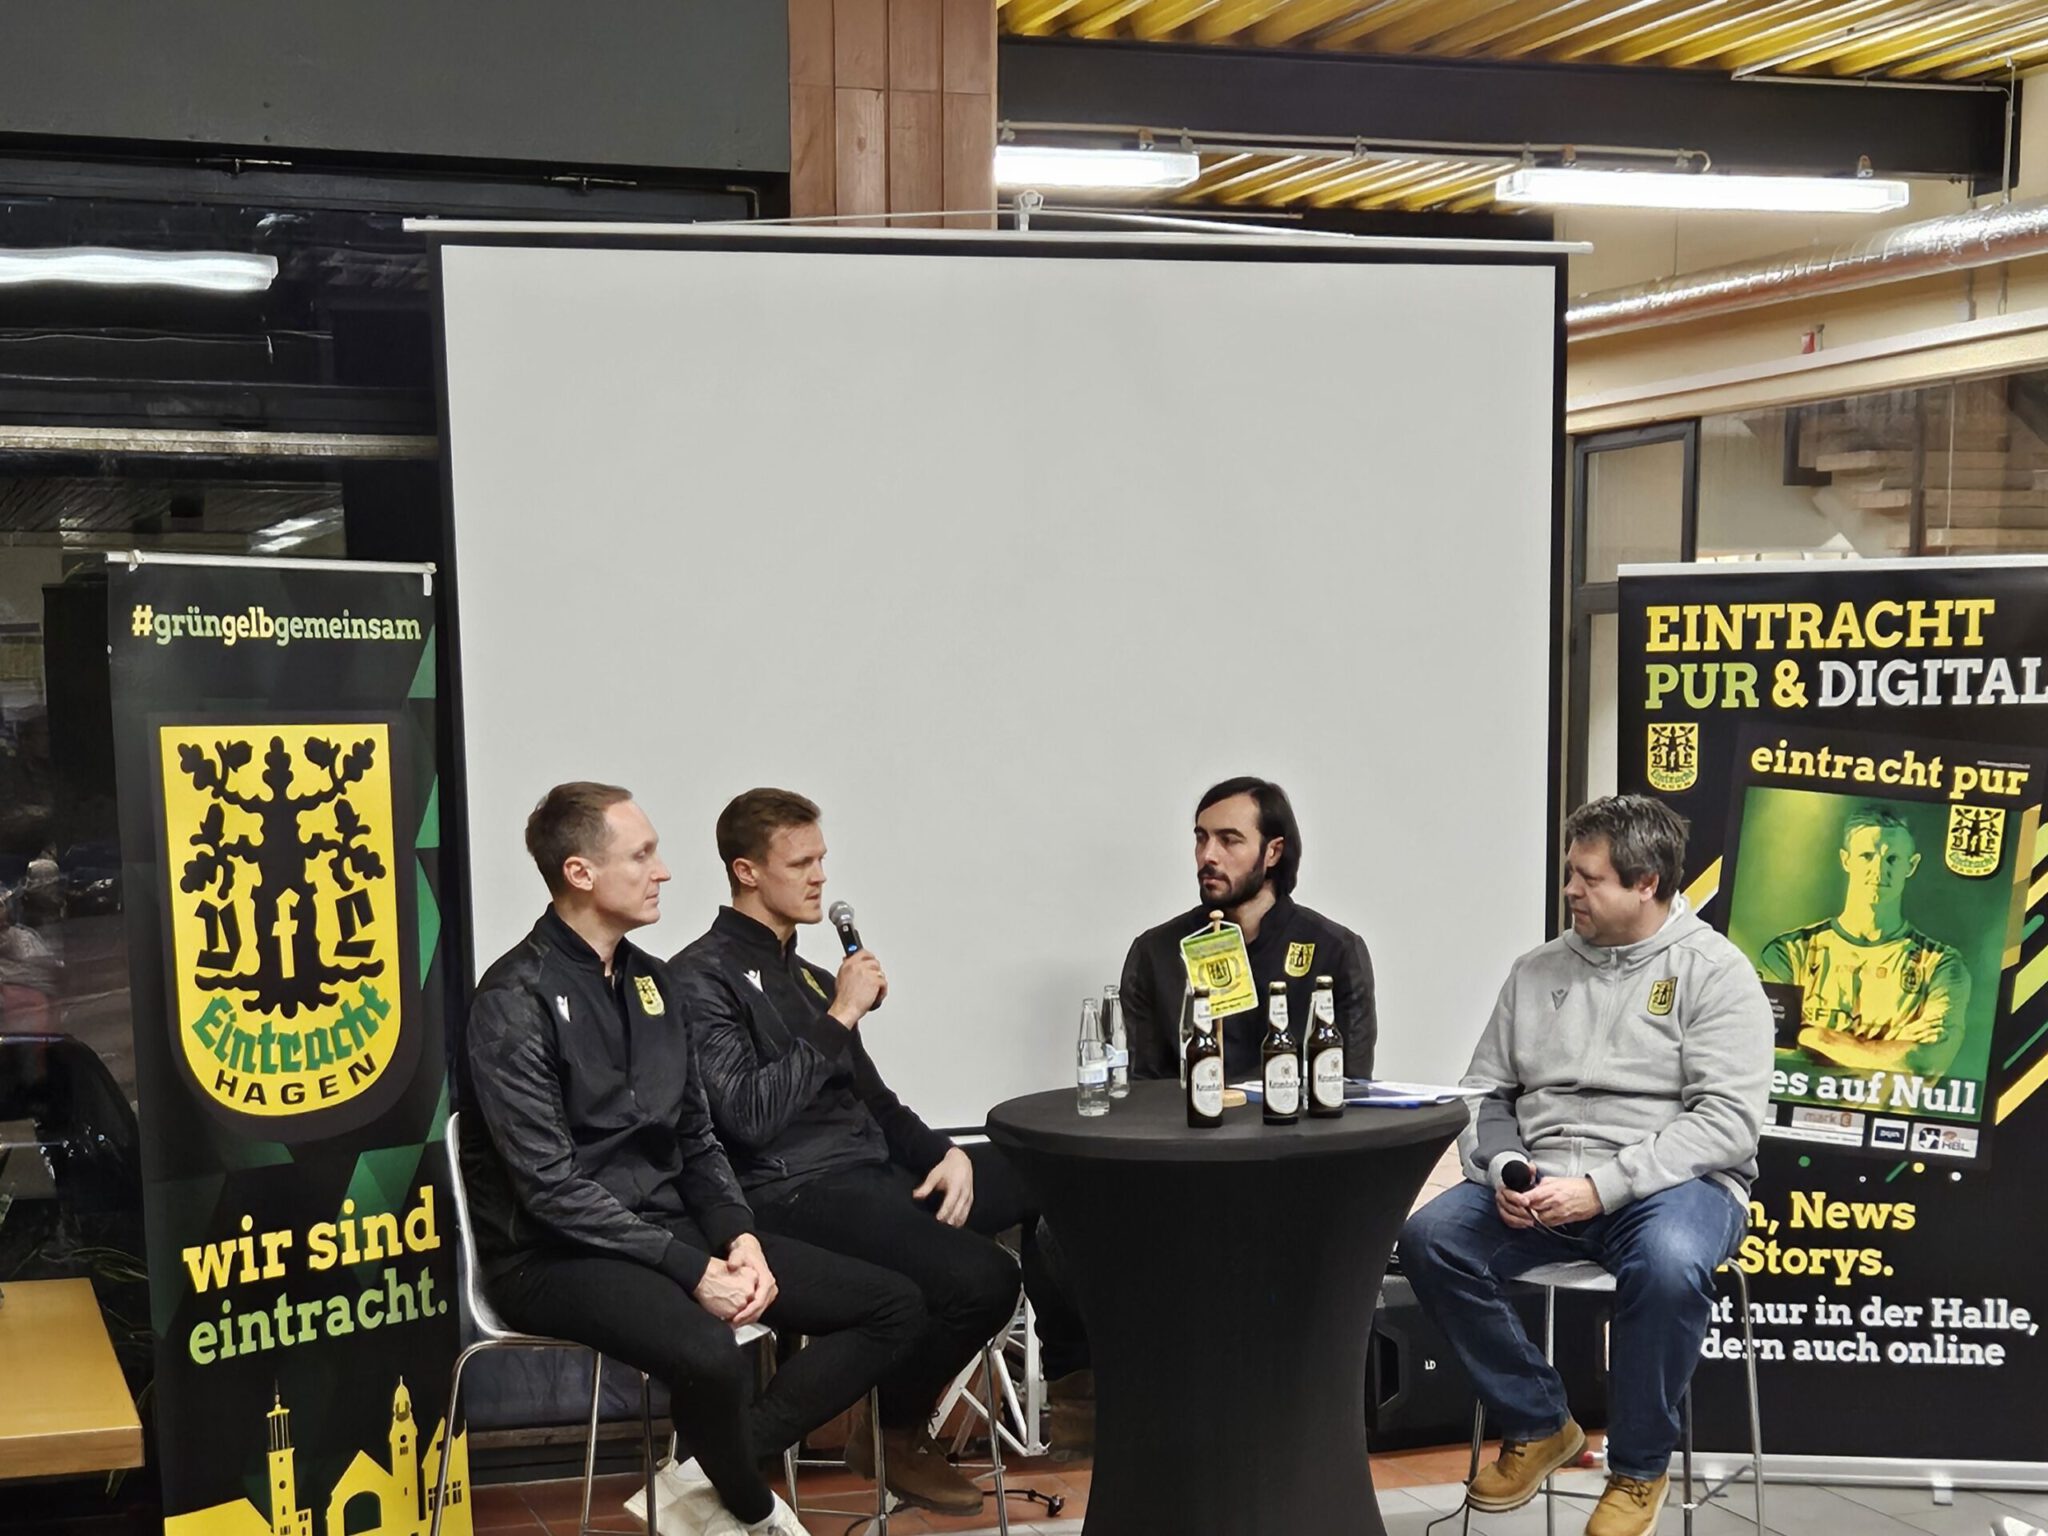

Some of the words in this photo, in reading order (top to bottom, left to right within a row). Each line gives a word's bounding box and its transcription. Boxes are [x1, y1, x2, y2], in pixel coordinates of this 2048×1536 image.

[131, 604, 422, 647] #grüngelbgemeinsam
[1645, 598, 1996, 653] EINTRACHT
[1644, 662, 1760, 710] PUR
[1772, 659, 1809, 708] &
[1818, 656, 2048, 708] DIGITAL
[1750, 739, 1943, 788] eintracht
[1949, 766, 2029, 800] pur
[191, 981, 392, 1075] Eintracht
[214, 1052, 377, 1106] HAGEN
[1769, 1069, 1810, 1096] es
[1816, 1072, 1887, 1105] auf
[1889, 1073, 1977, 1115] Null
[182, 1214, 293, 1294] wir
[307, 1184, 441, 1271] sind
[1746, 1200, 1780, 1236] n,
[1789, 1190, 1917, 1231] News
[1738, 1235, 1895, 1286] Storys.
[189, 1266, 449, 1366] eintracht.
[1741, 1300, 1808, 1325] nur
[1814, 1295, 1854, 1326] in
[1860, 1295, 1924, 1328] der
[1930, 1297, 2040, 1337] Halle,
[1424, 1359, 1437, 1371] LD
[1700, 1328, 1786, 1361] dern
[1792, 1331, 1881, 1363] auch
[1887, 1333, 2007, 1366] online
